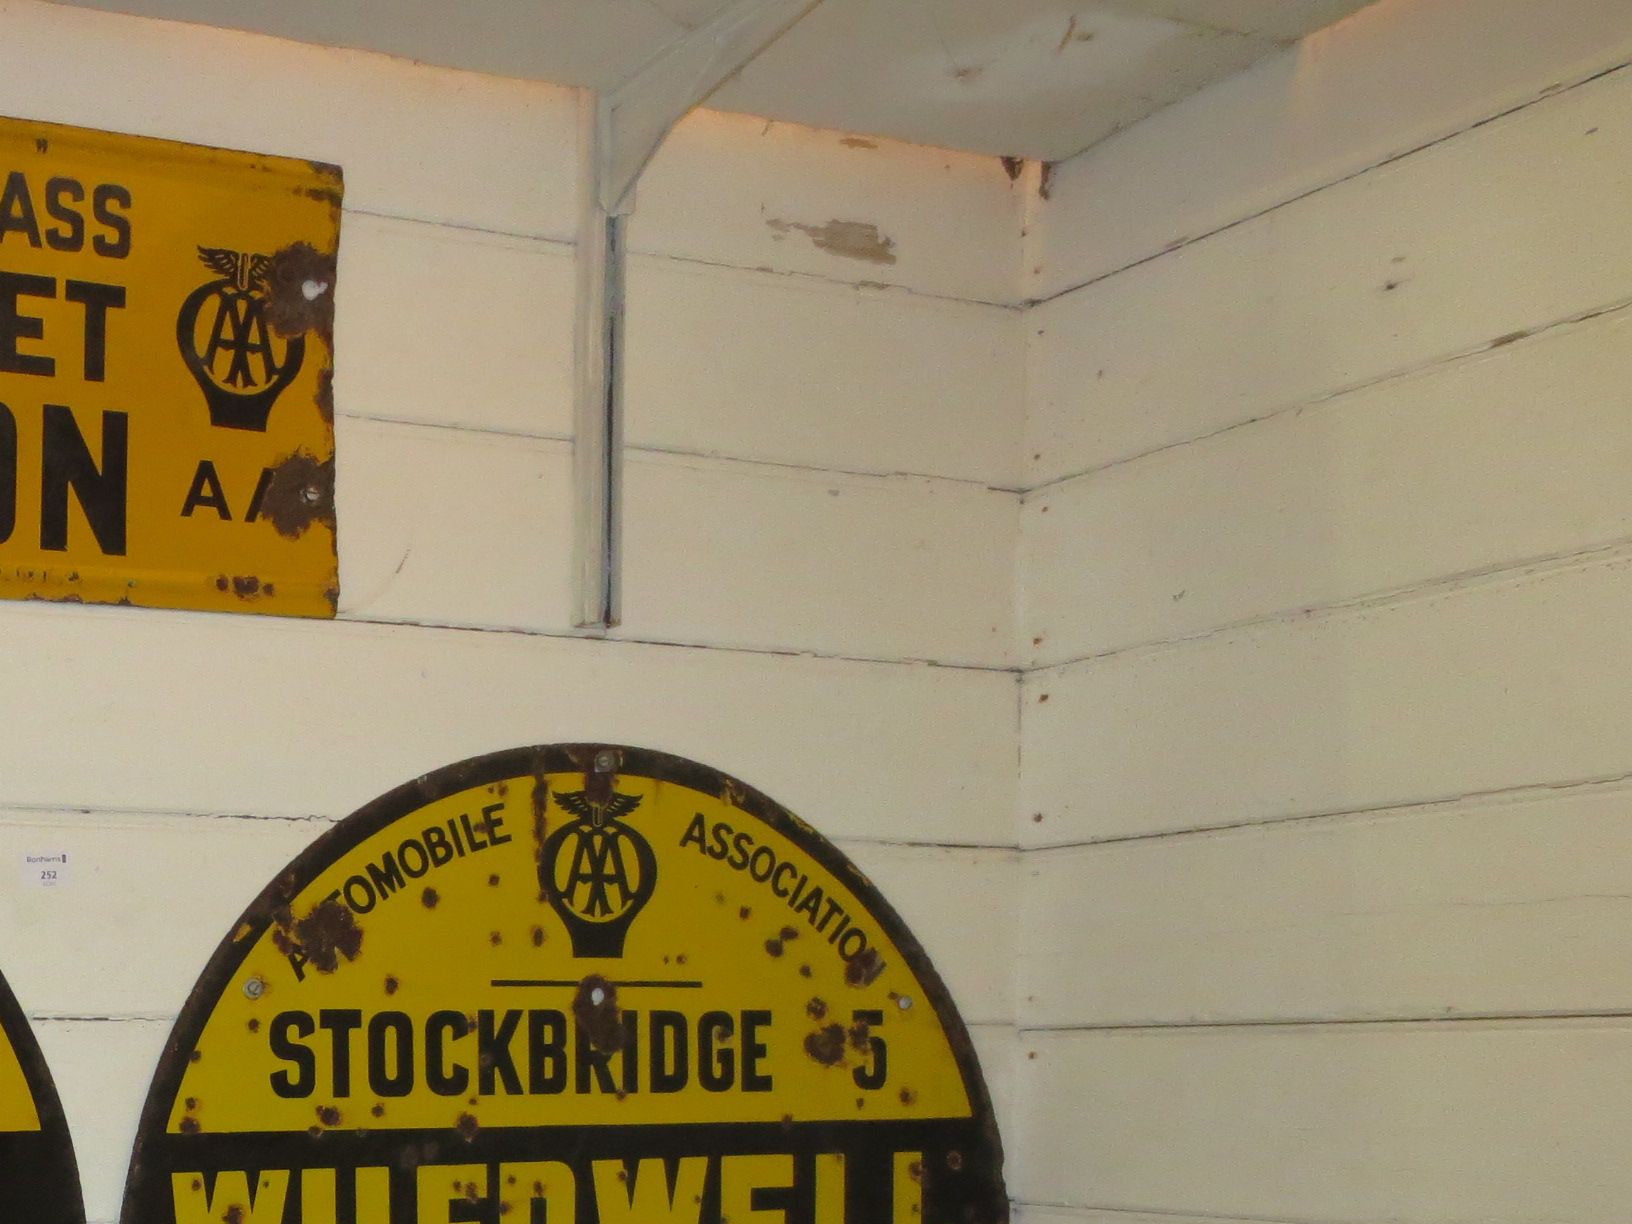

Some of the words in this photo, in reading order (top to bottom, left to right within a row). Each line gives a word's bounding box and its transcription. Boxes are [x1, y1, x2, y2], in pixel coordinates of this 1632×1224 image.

[41, 870, 57, 880] 252
[285, 802, 512, 983] AOMOBILE
[679, 813, 886, 985] ASSOCIATIO
[270, 1009, 773, 1099] STOCKBRIDGE
[851, 1009, 887, 1090] 5
